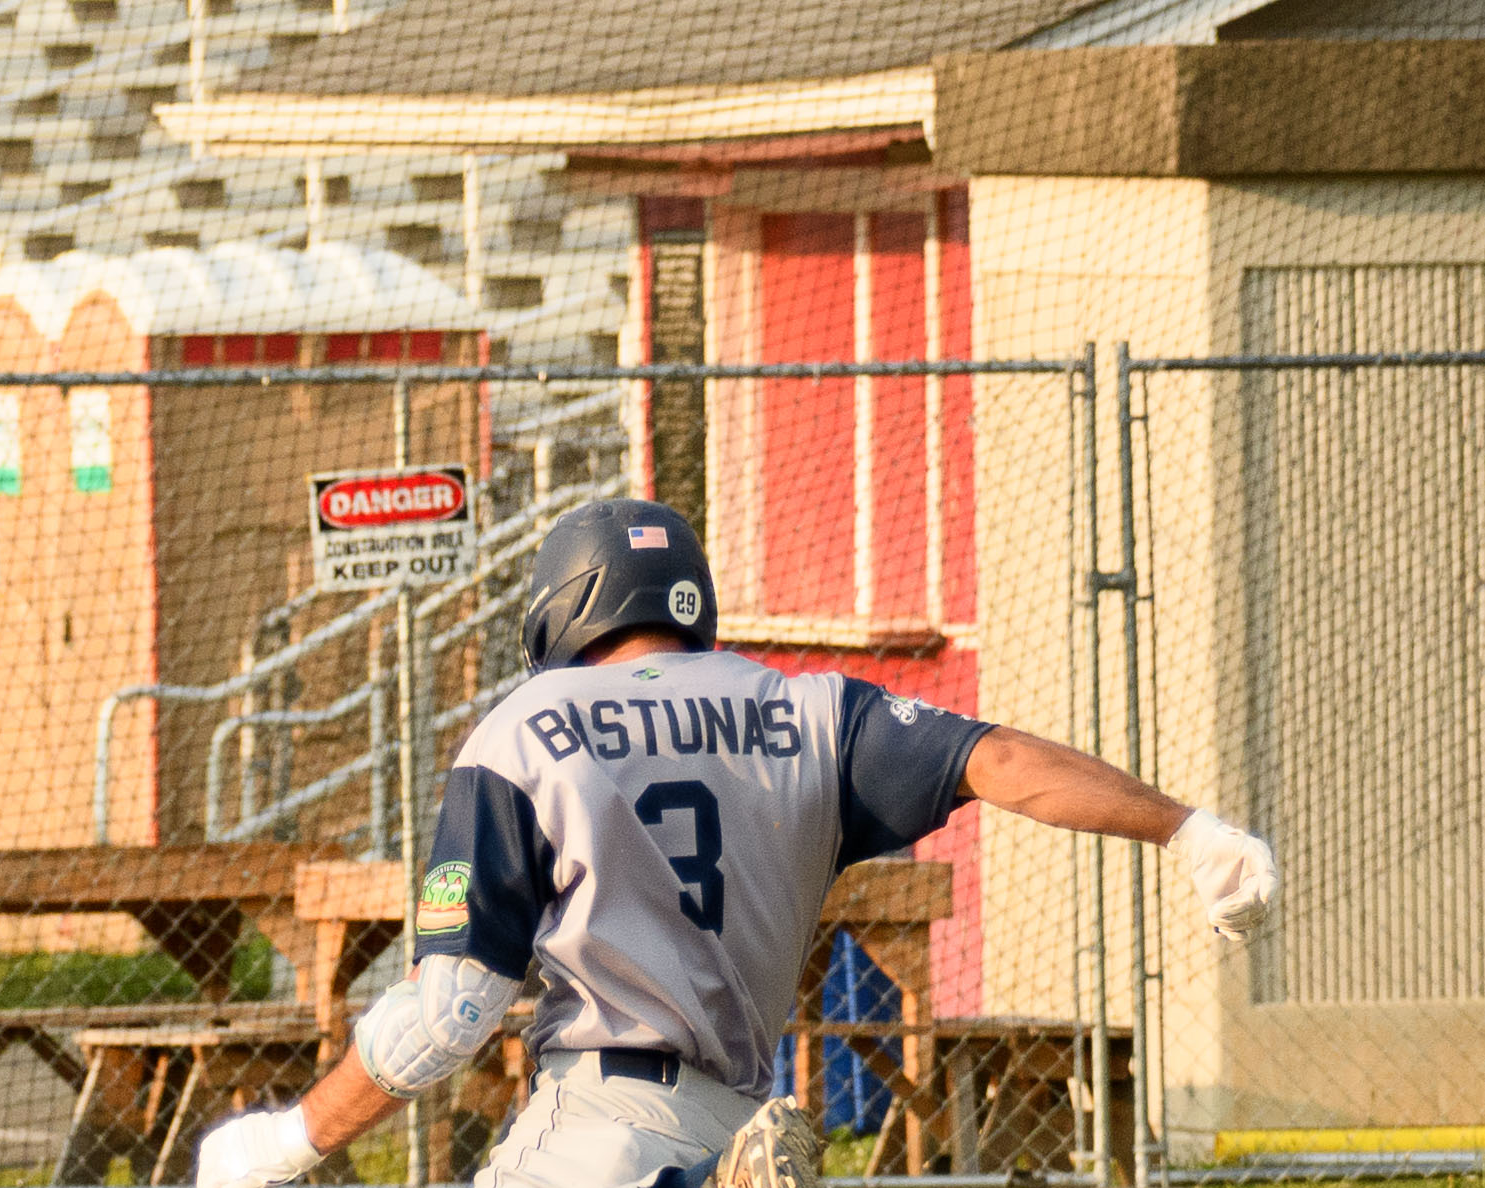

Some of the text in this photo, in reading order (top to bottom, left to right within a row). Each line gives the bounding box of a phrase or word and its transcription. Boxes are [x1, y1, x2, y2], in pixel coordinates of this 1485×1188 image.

[329, 485, 454, 517] DANGER
[334, 554, 458, 580] KEEP OUT
[676, 591, 696, 616] 29
[526, 698, 801, 762] BISTUNAS
[634, 780, 725, 936] 3
